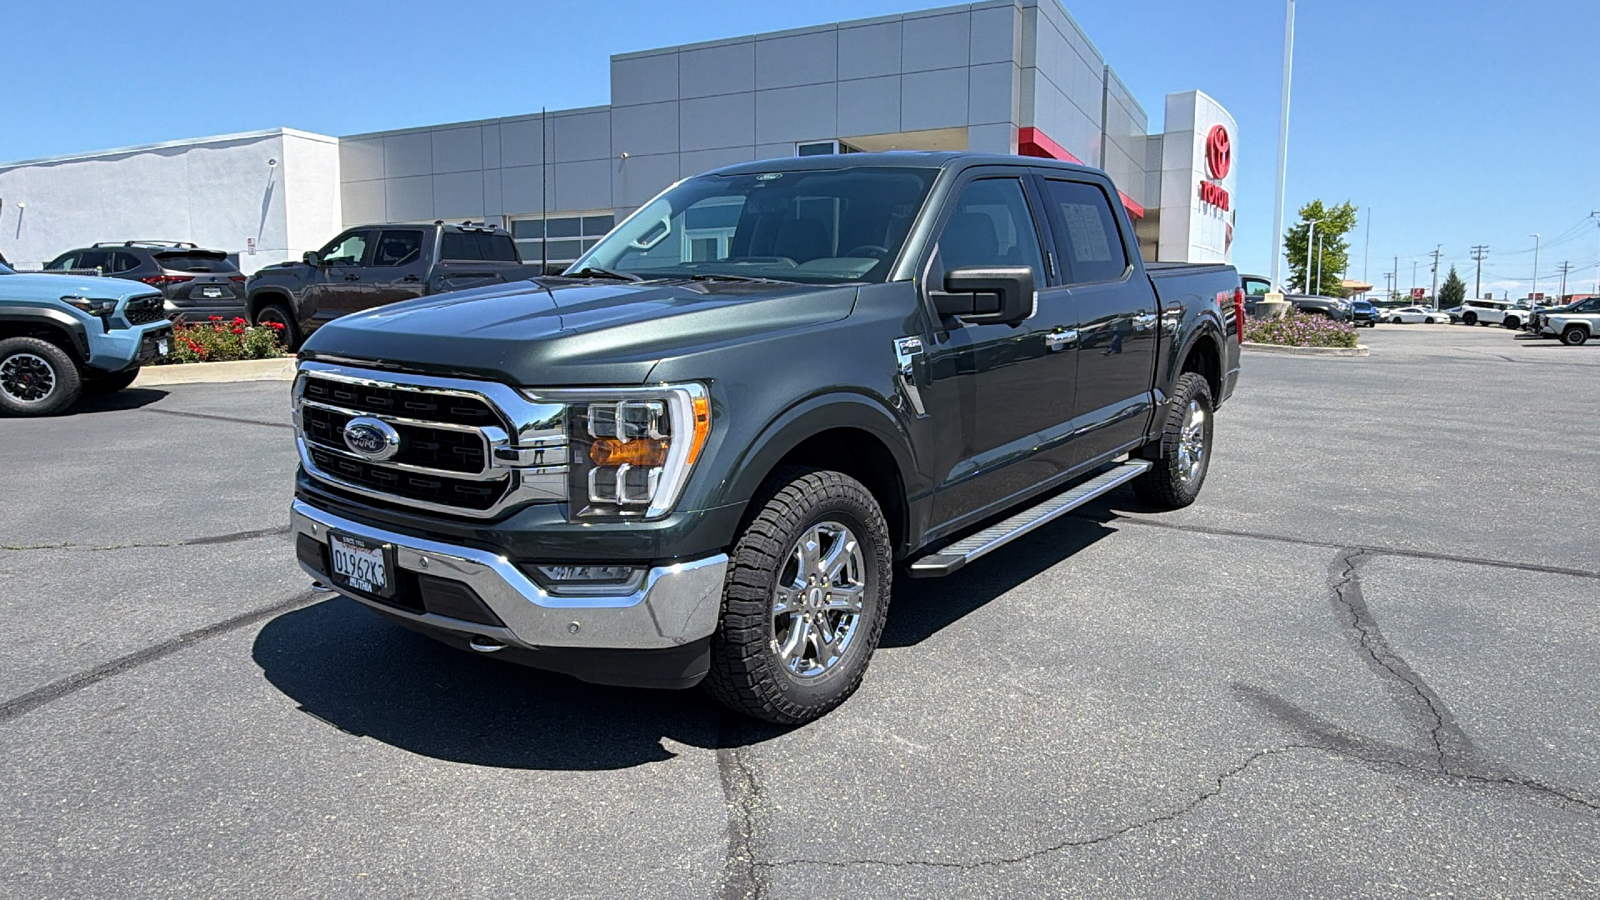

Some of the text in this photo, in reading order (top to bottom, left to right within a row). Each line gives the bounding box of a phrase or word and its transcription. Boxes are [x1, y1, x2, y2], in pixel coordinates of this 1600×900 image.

[1199, 180, 1229, 211] TOYOT
[350, 427, 378, 449] Ford
[335, 549, 386, 587] 01962K3
